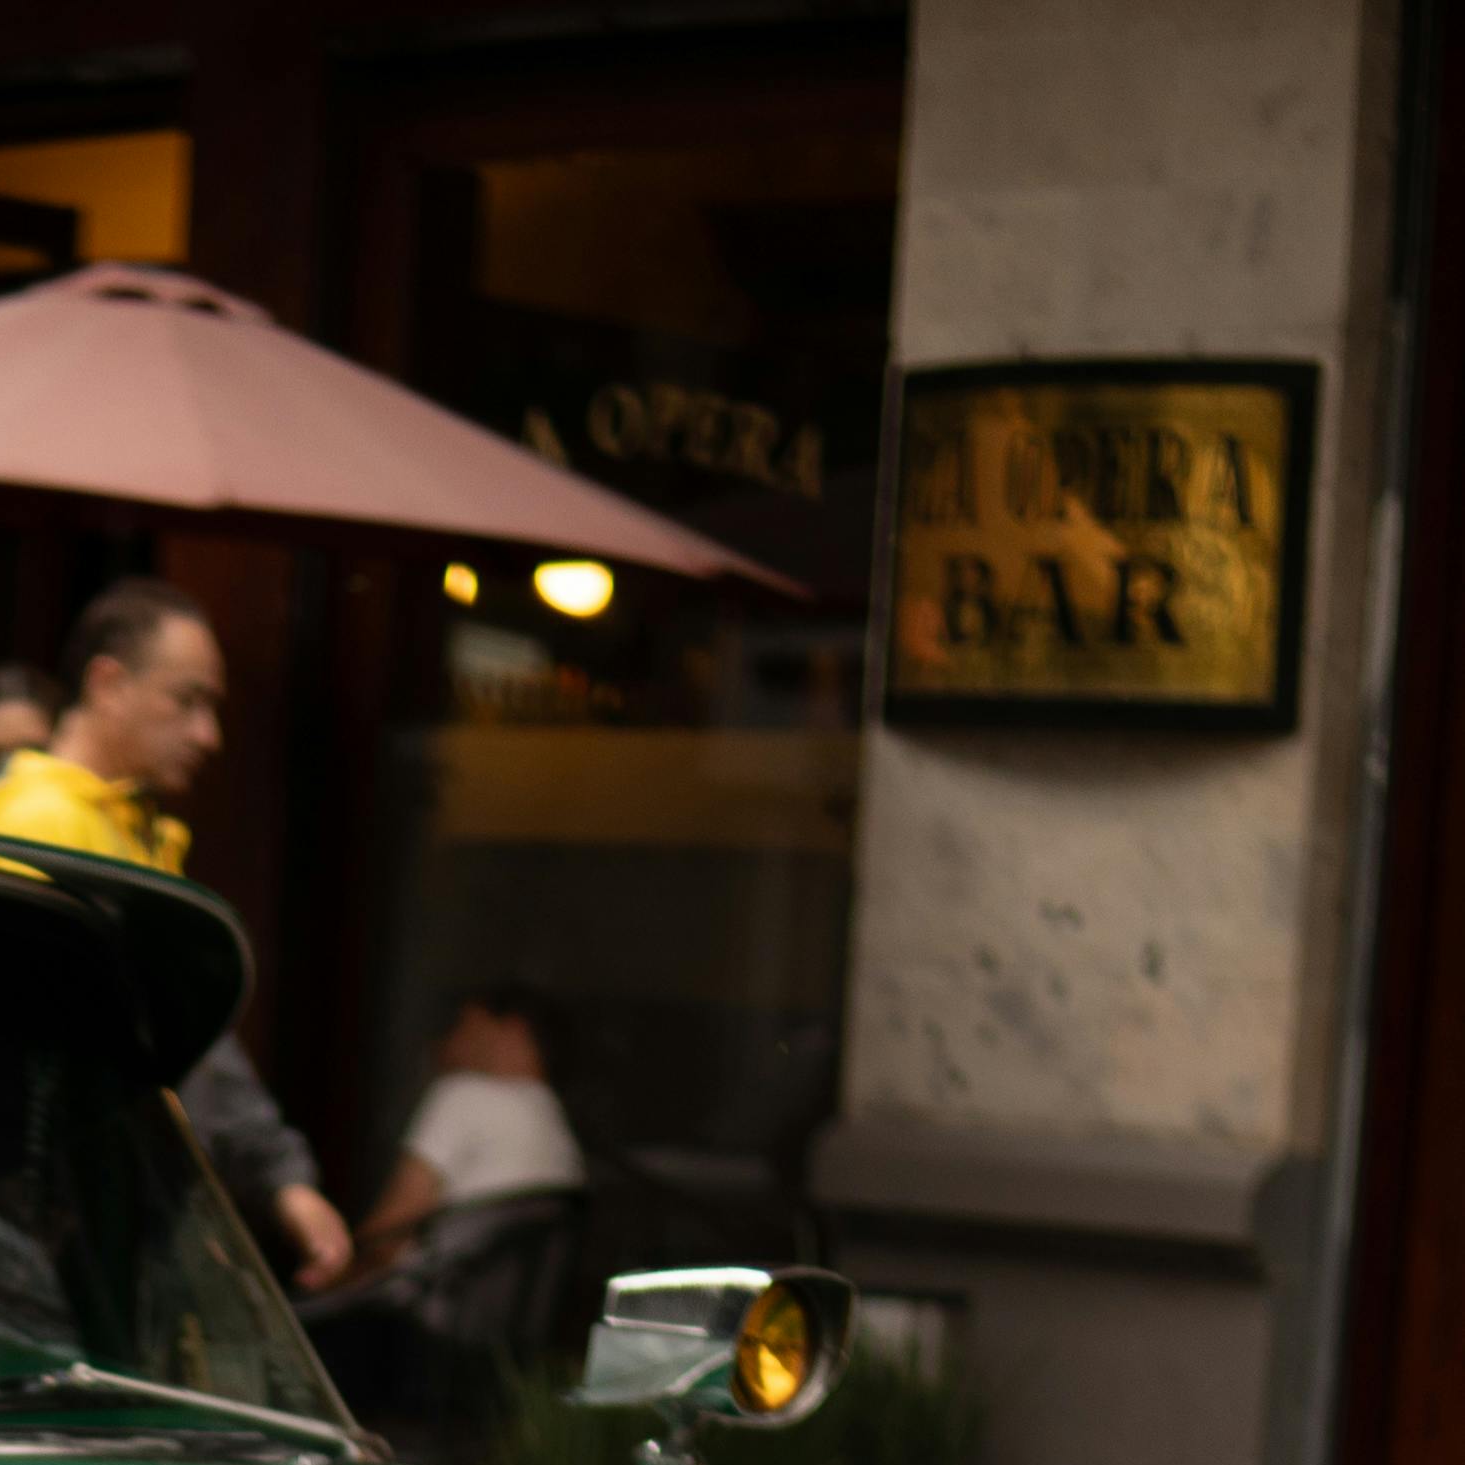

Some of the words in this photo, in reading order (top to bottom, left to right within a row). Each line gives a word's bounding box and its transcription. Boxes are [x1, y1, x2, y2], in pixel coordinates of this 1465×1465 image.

[587, 380, 824, 502] OPERA
[1002, 426, 1256, 530] OPERA
[944, 554, 1186, 646] BAR
